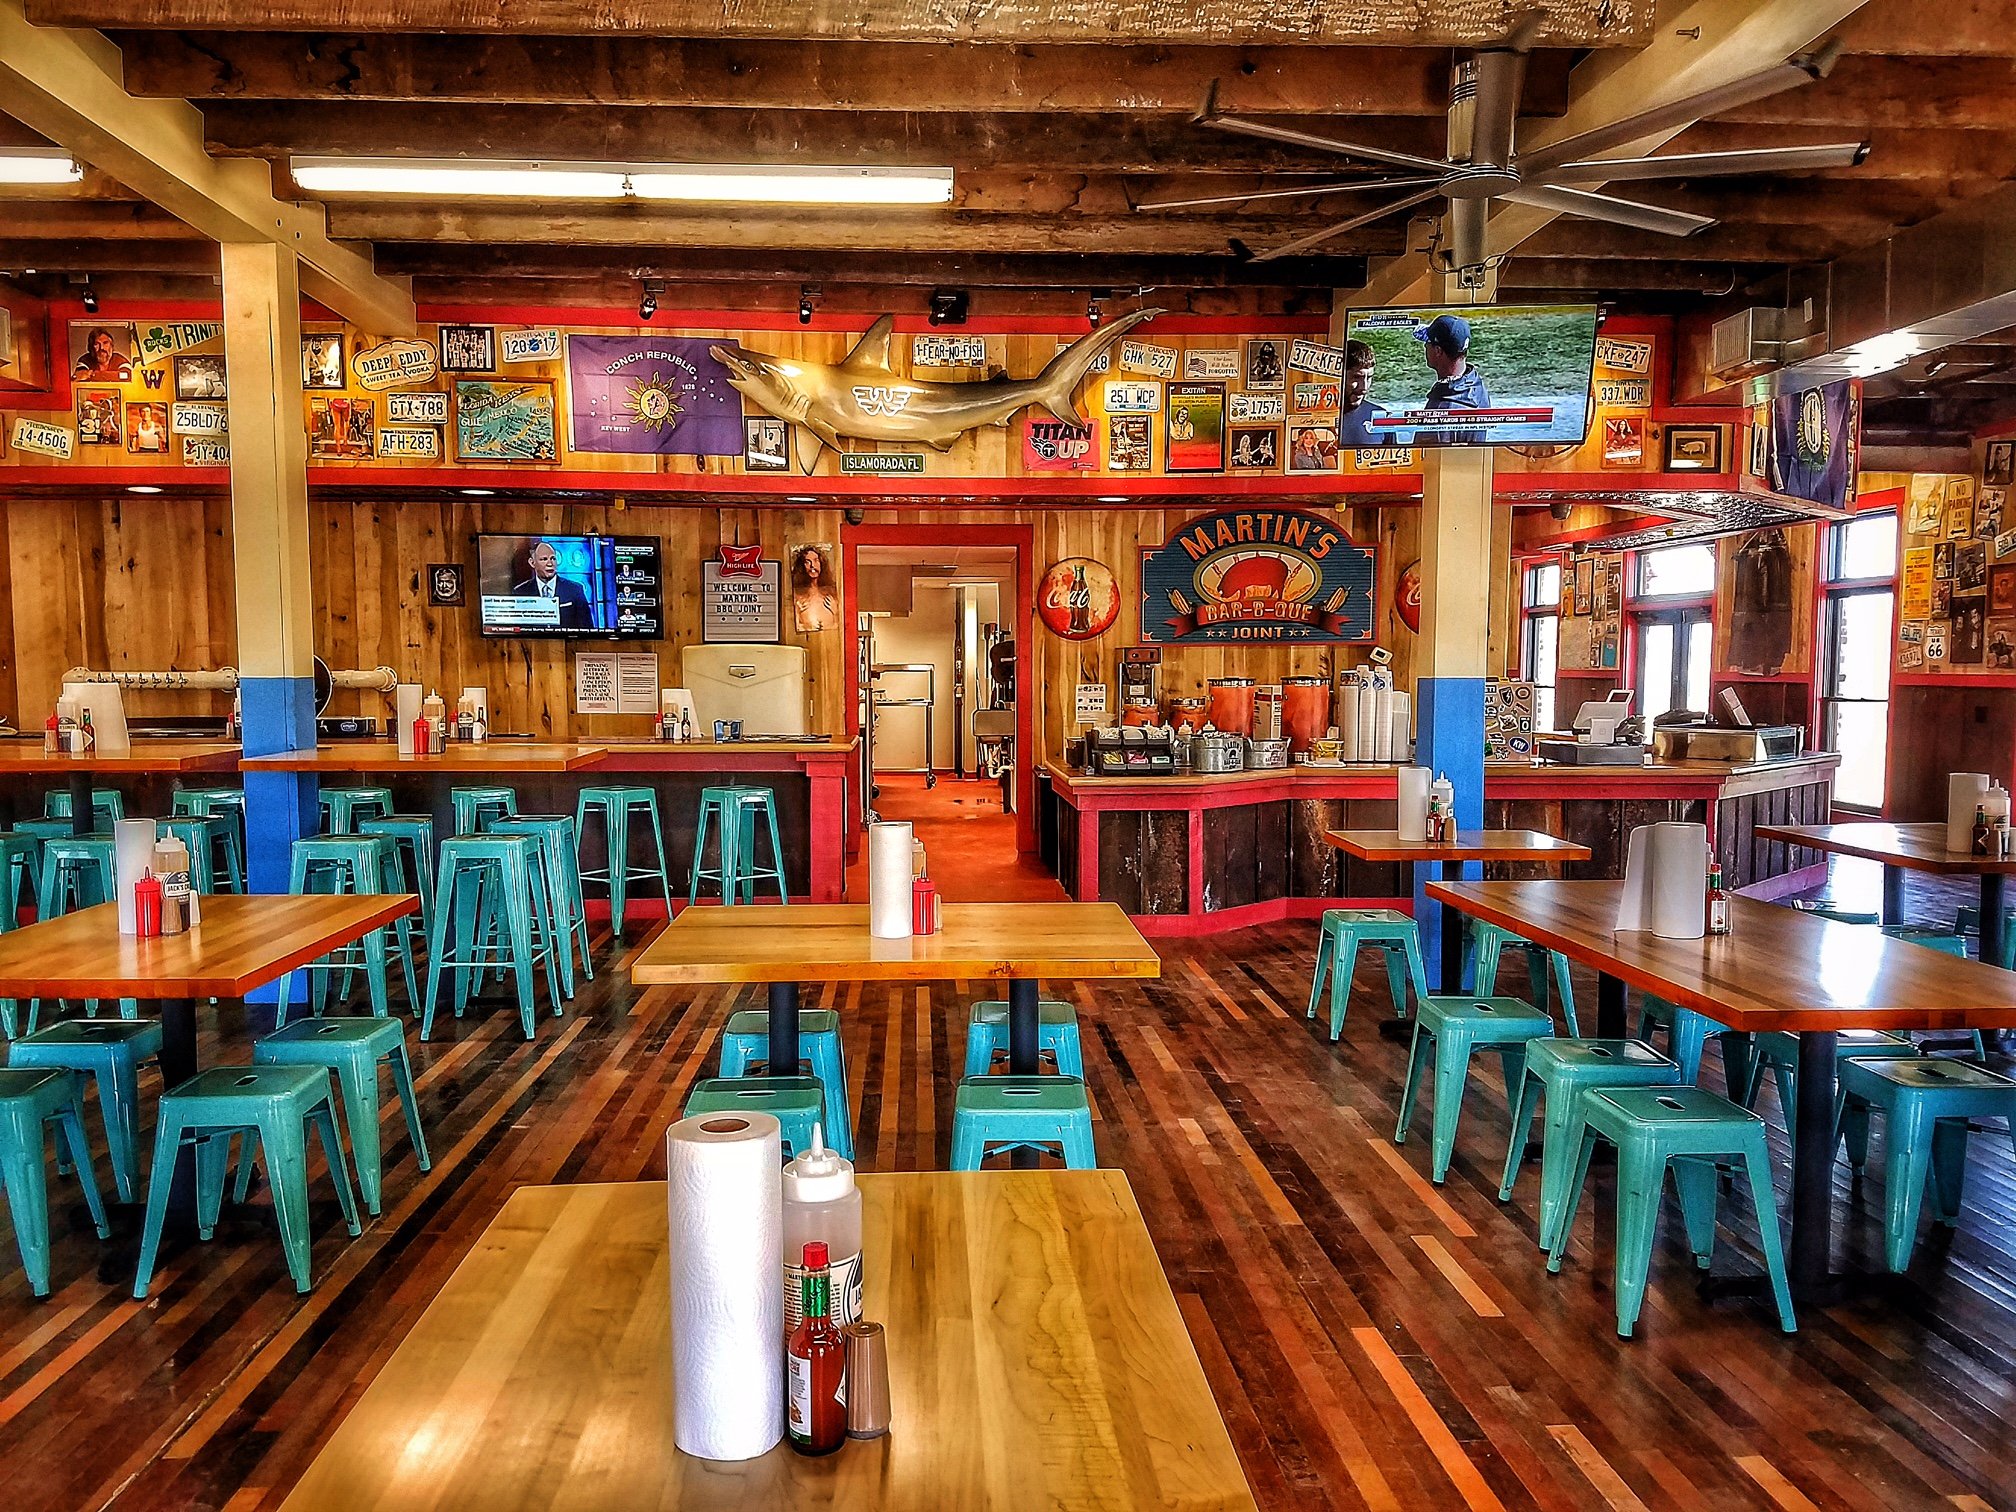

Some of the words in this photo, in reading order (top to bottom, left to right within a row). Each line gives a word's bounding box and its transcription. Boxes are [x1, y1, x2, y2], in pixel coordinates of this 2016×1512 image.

[362, 356, 390, 373] DEEP
[398, 349, 427, 366] EDDY
[1124, 349, 1144, 364] GHK
[1151, 354, 1173, 369] 527
[1597, 346, 1618, 360] CKF
[1624, 350, 1646, 364] 247
[606, 352, 643, 374] CONCH
[647, 351, 697, 375] REPUBLIC
[1111, 390, 1129, 403] 251
[1601, 387, 1620, 400] 337
[1251, 400, 1276, 414] 1757
[1031, 423, 1093, 441] TITAN
[1058, 440, 1090, 459] UP
[846, 457, 906, 470] ISLAMORADA,
[908, 458, 919, 470] FL
[1955, 483, 1966, 496] NO
[1180, 513, 1339, 561] MARTIN'S
[713, 583, 753, 592] WELCOME
[761, 583, 771, 592] TO
[722, 594, 758, 603] MARTINS
[716, 605, 733, 613] BBQ
[738, 605, 762, 613] JOINT
[1205, 600, 1314, 622] BAR-B-QUE
[1231, 626, 1284, 640] JOINT
[1928, 644, 1942, 657] 66
